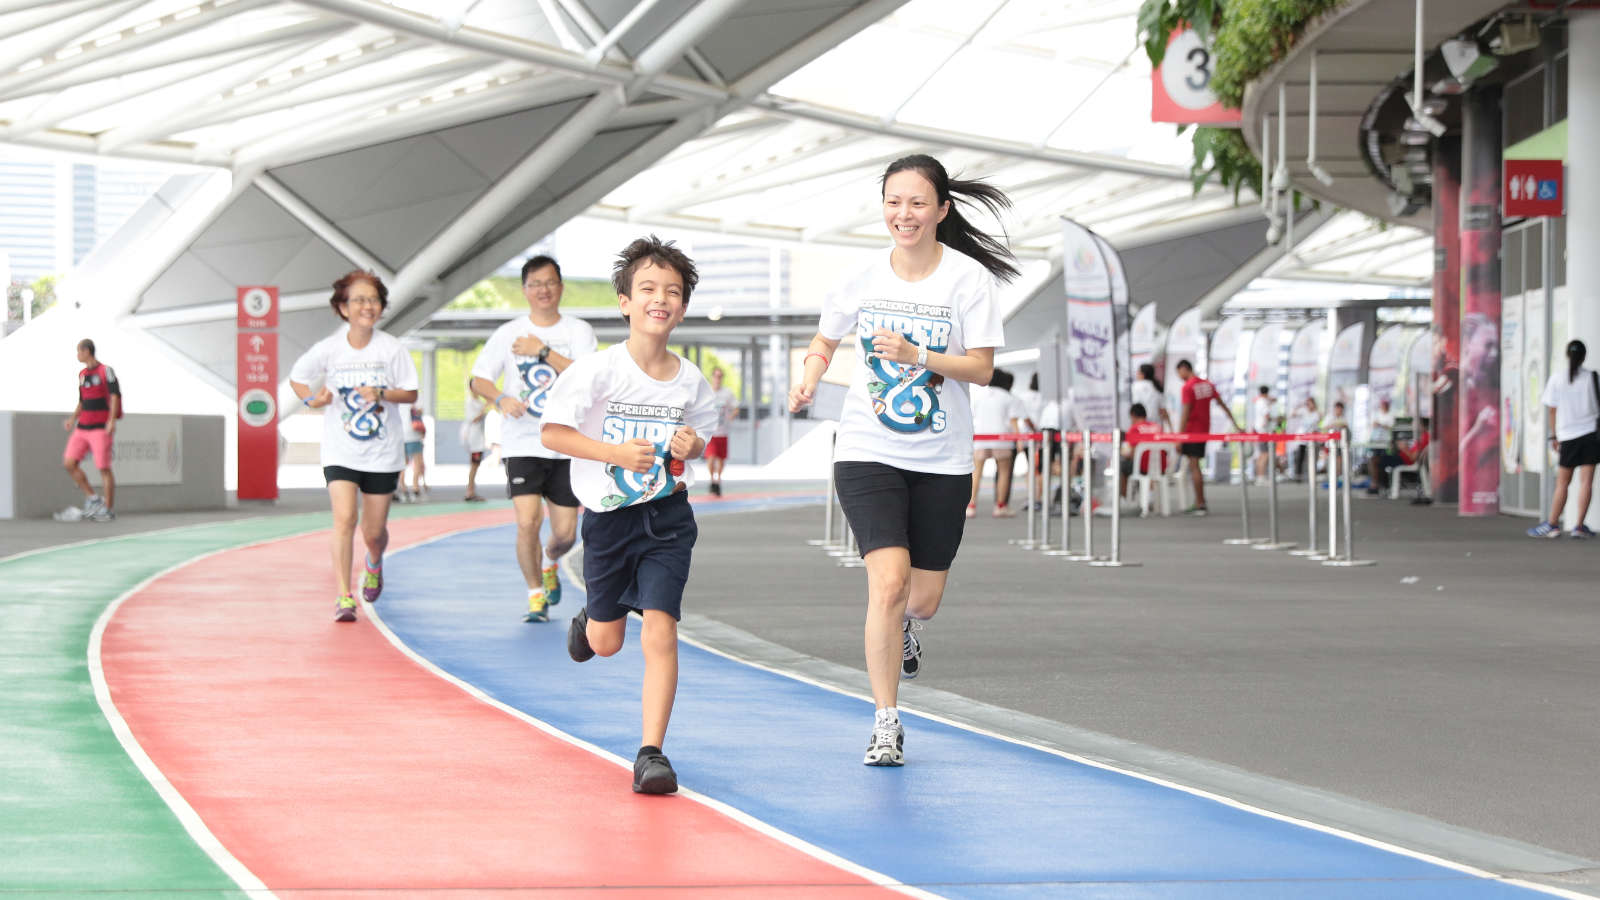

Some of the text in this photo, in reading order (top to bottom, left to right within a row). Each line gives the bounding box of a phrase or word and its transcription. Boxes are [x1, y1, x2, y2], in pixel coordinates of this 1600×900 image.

[1185, 47, 1212, 92] 3
[250, 294, 264, 312] 3
[857, 309, 952, 350] SUPER
[335, 370, 388, 388] SUPER
[606, 400, 669, 418] EXPERIENCE
